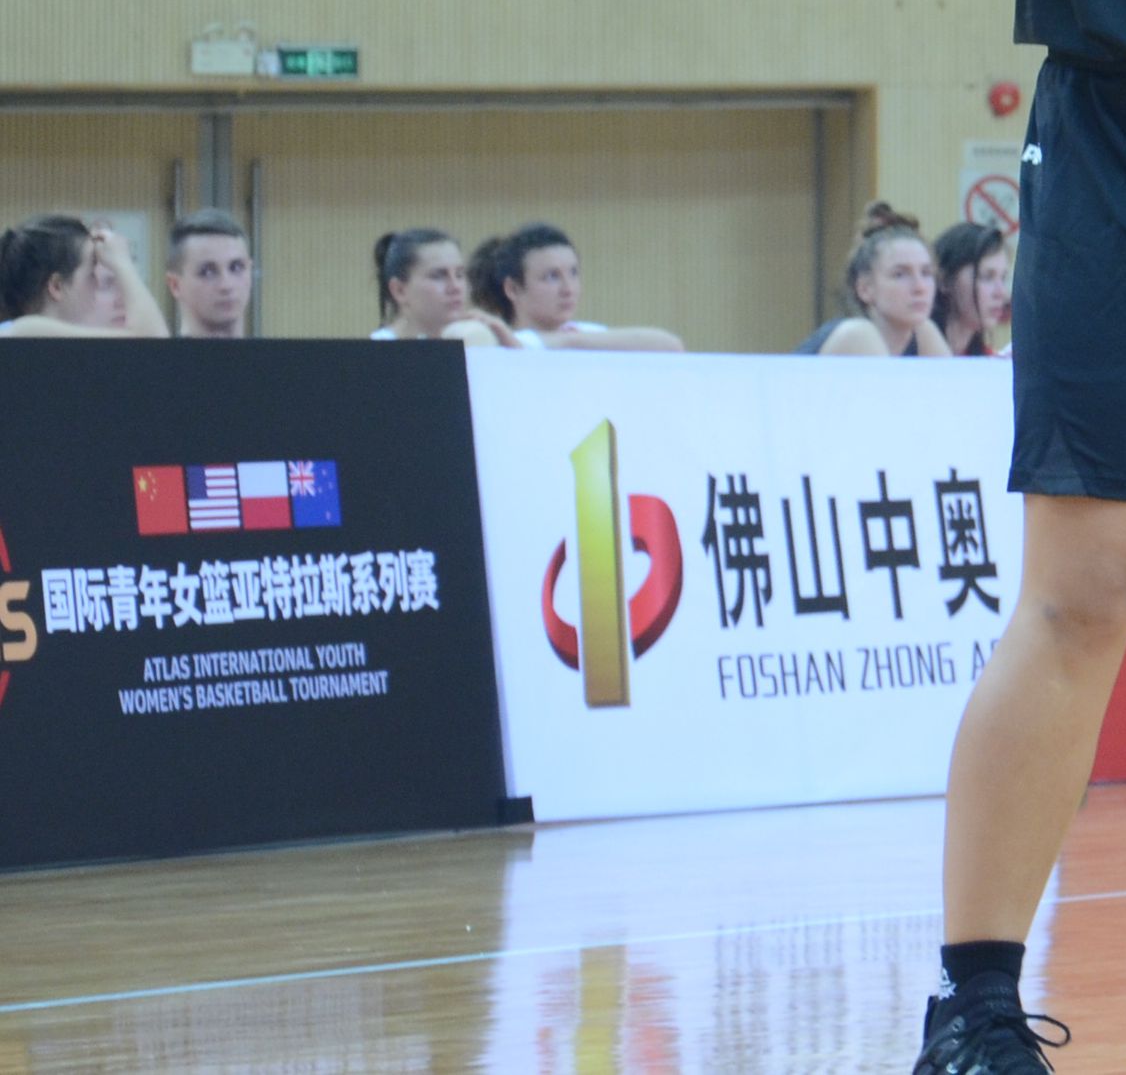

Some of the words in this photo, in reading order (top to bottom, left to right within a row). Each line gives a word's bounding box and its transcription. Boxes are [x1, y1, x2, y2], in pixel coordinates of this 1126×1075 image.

[701, 467, 1001, 628] 佛山中奥
[41, 548, 440, 635] 国际青年女篮亚特拉斯系列赛
[118, 686, 194, 715] WOMEN'S
[195, 676, 288, 710] BASKETBALL
[288, 671, 389, 702] TOURNAMENT
[143, 654, 191, 683] ATLAS
[191, 647, 315, 678] INTERNATIONAL
[315, 642, 367, 667] YOUTH
[717, 650, 847, 700] FOSHAN
[856, 641, 957, 691] ZHONG
[972, 638, 1000, 681] A
